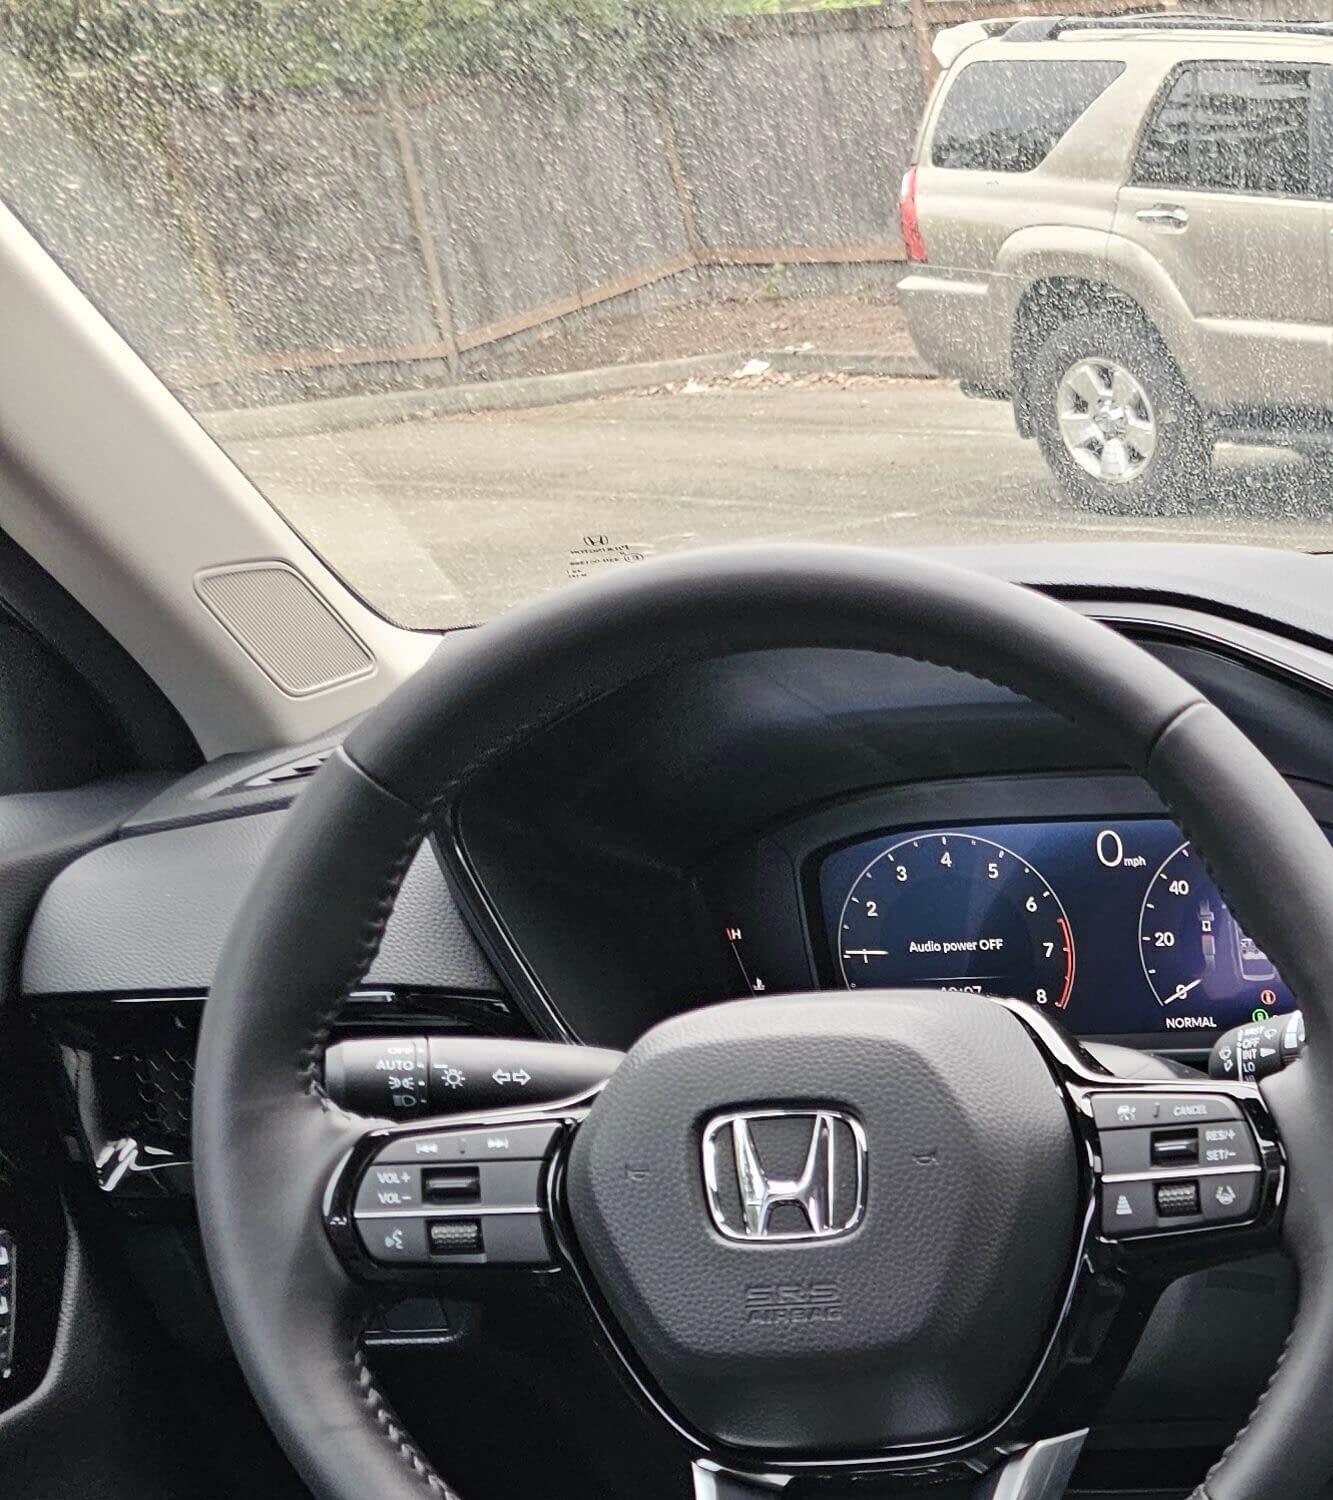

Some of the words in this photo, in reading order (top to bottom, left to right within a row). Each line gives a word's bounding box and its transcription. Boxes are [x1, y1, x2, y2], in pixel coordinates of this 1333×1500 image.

[1096, 830, 1123, 867] 0
[1124, 855, 1146, 868] mph
[940, 852, 952, 868] 4
[896, 866, 908, 882] 3
[988, 863, 999, 878] 5
[1169, 880, 1189, 895] 40
[865, 901, 878, 918] 2
[1025, 896, 1038, 912] 6
[909, 940, 941, 953] Audio
[943, 941, 977, 955] power
[979, 938, 1004, 951] OFF
[1154, 931, 1175, 947] 20
[1043, 942, 1054, 958] 7
[1036, 988, 1047, 1004] 8
[1166, 1017, 1217, 1029] NORMAL
[376, 1059, 414, 1071] AUTO
